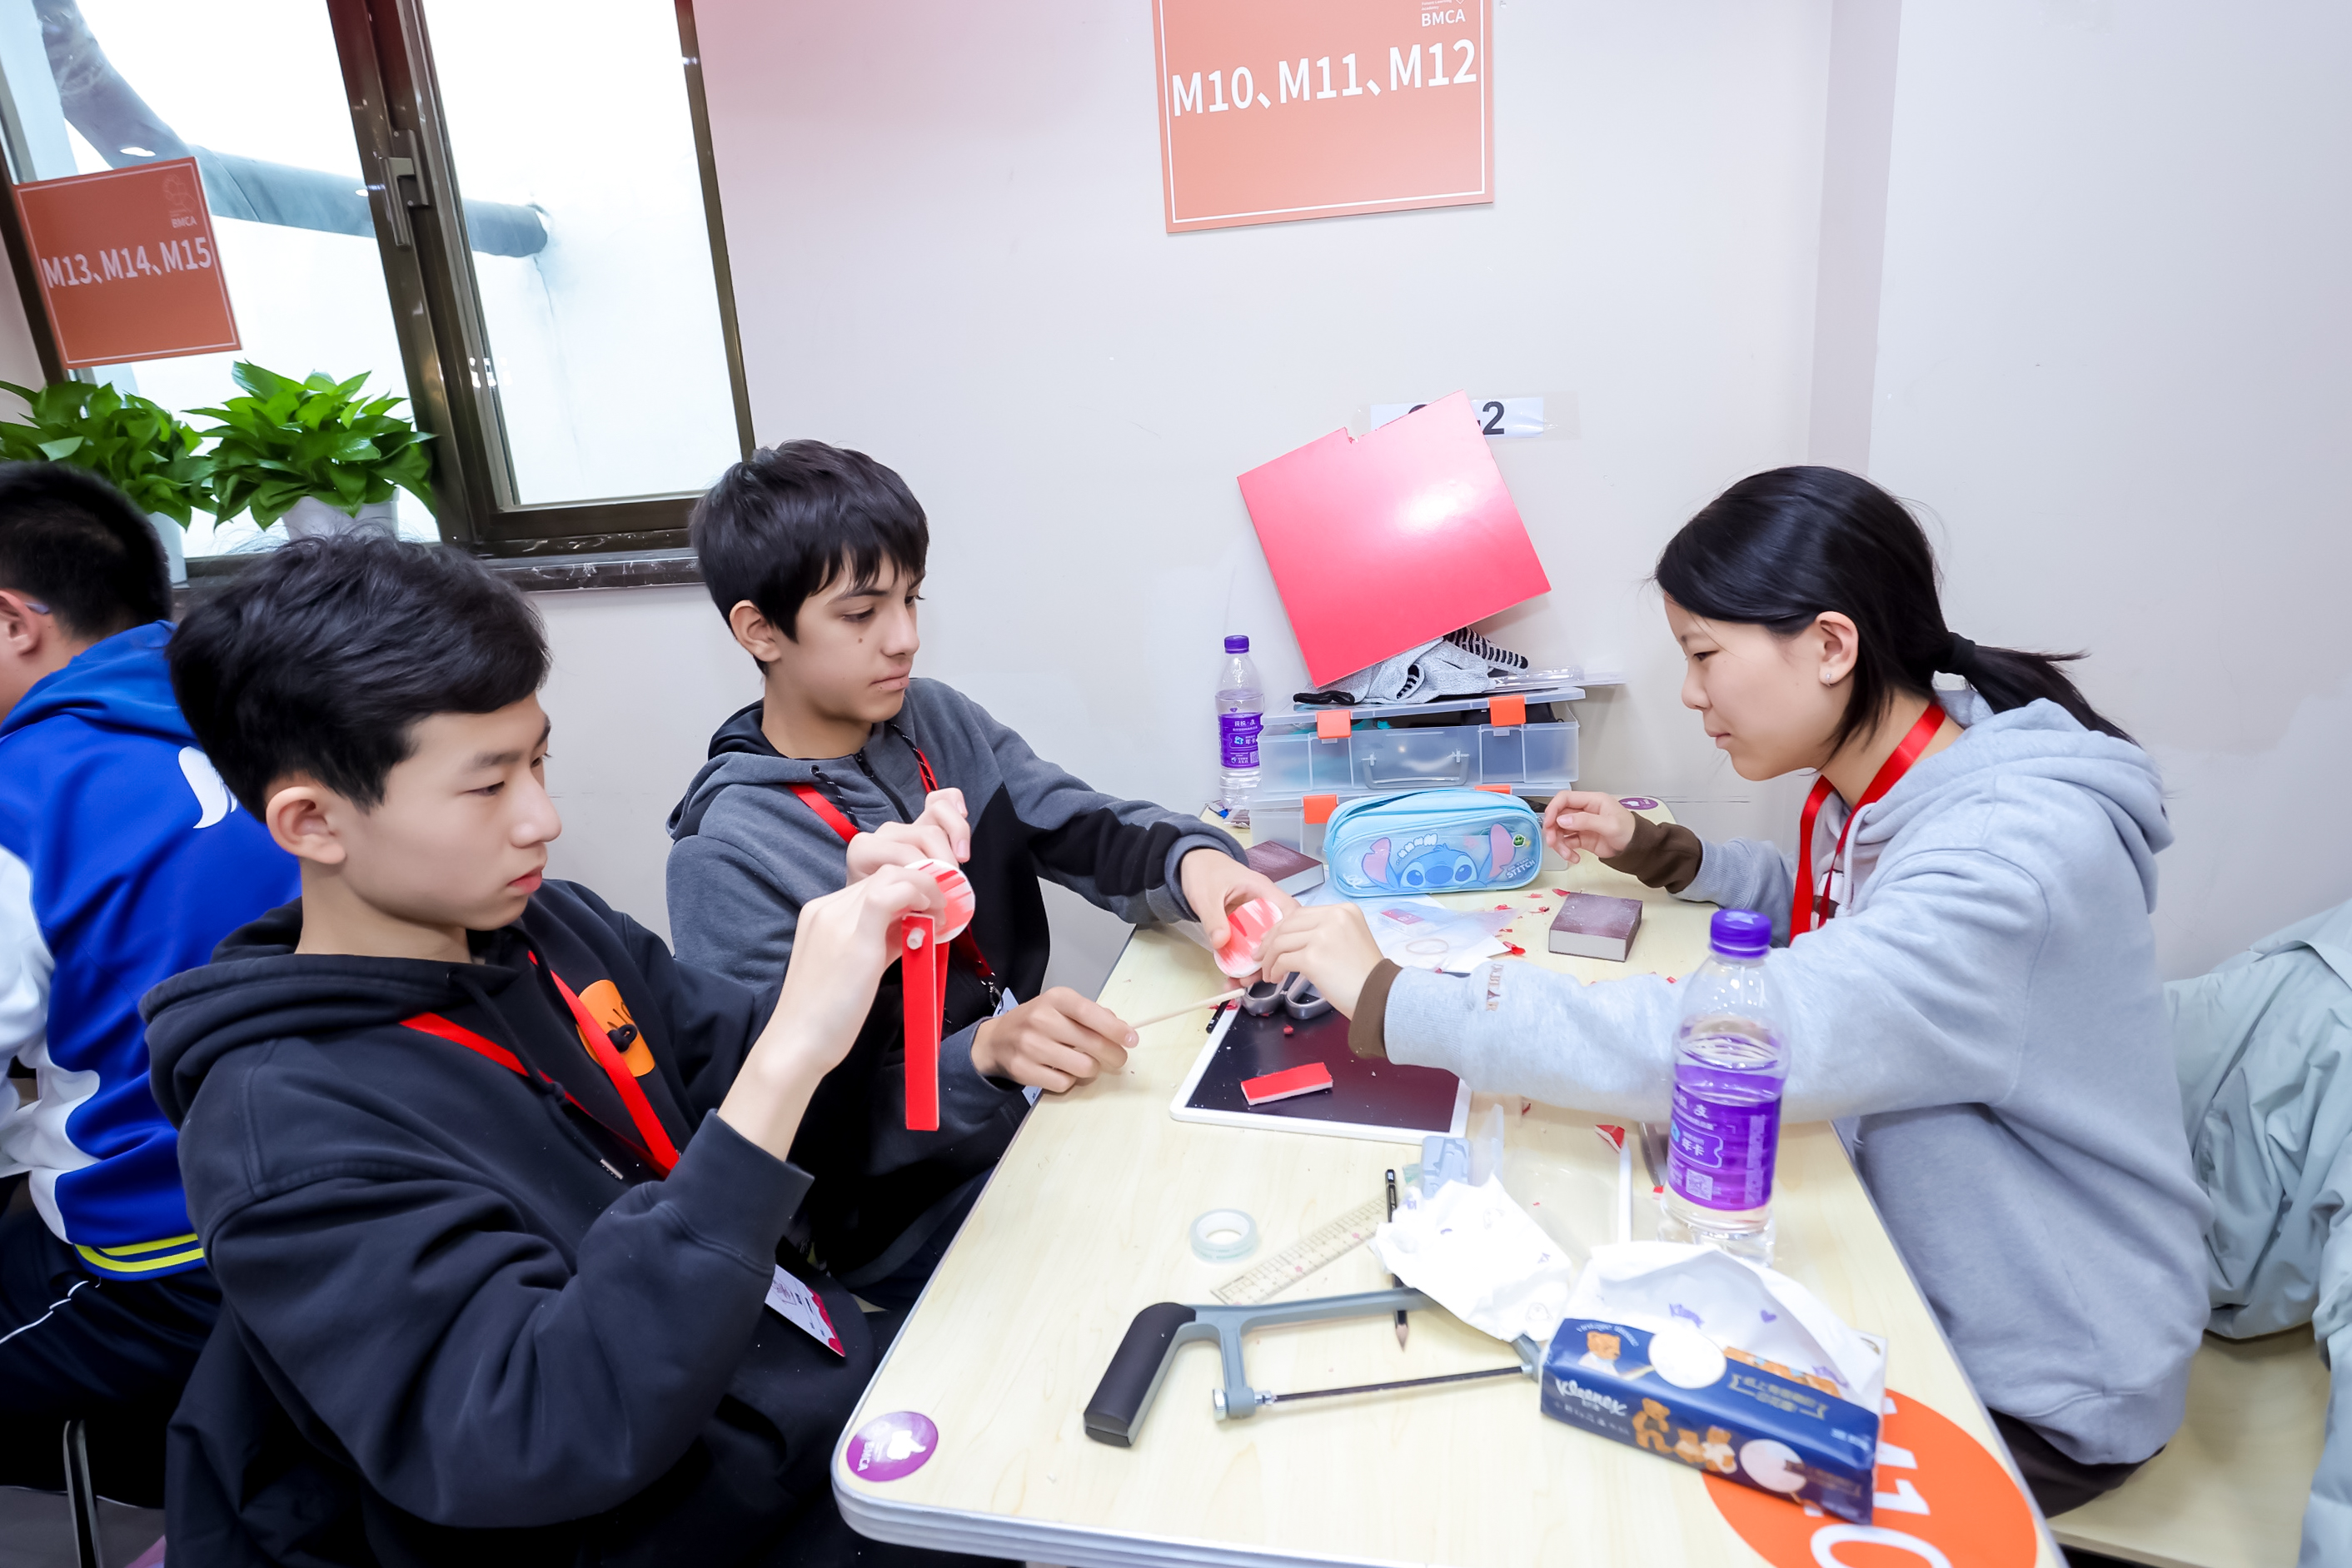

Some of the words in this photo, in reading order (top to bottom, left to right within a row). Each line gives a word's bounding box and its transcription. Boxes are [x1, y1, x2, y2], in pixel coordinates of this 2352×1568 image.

[1421, 8, 1466, 27] BMCA
[171, 216, 198, 229] BMCA
[1506, 859, 1536, 879] STITCH
[1555, 1378, 1627, 1416] Kleenex
